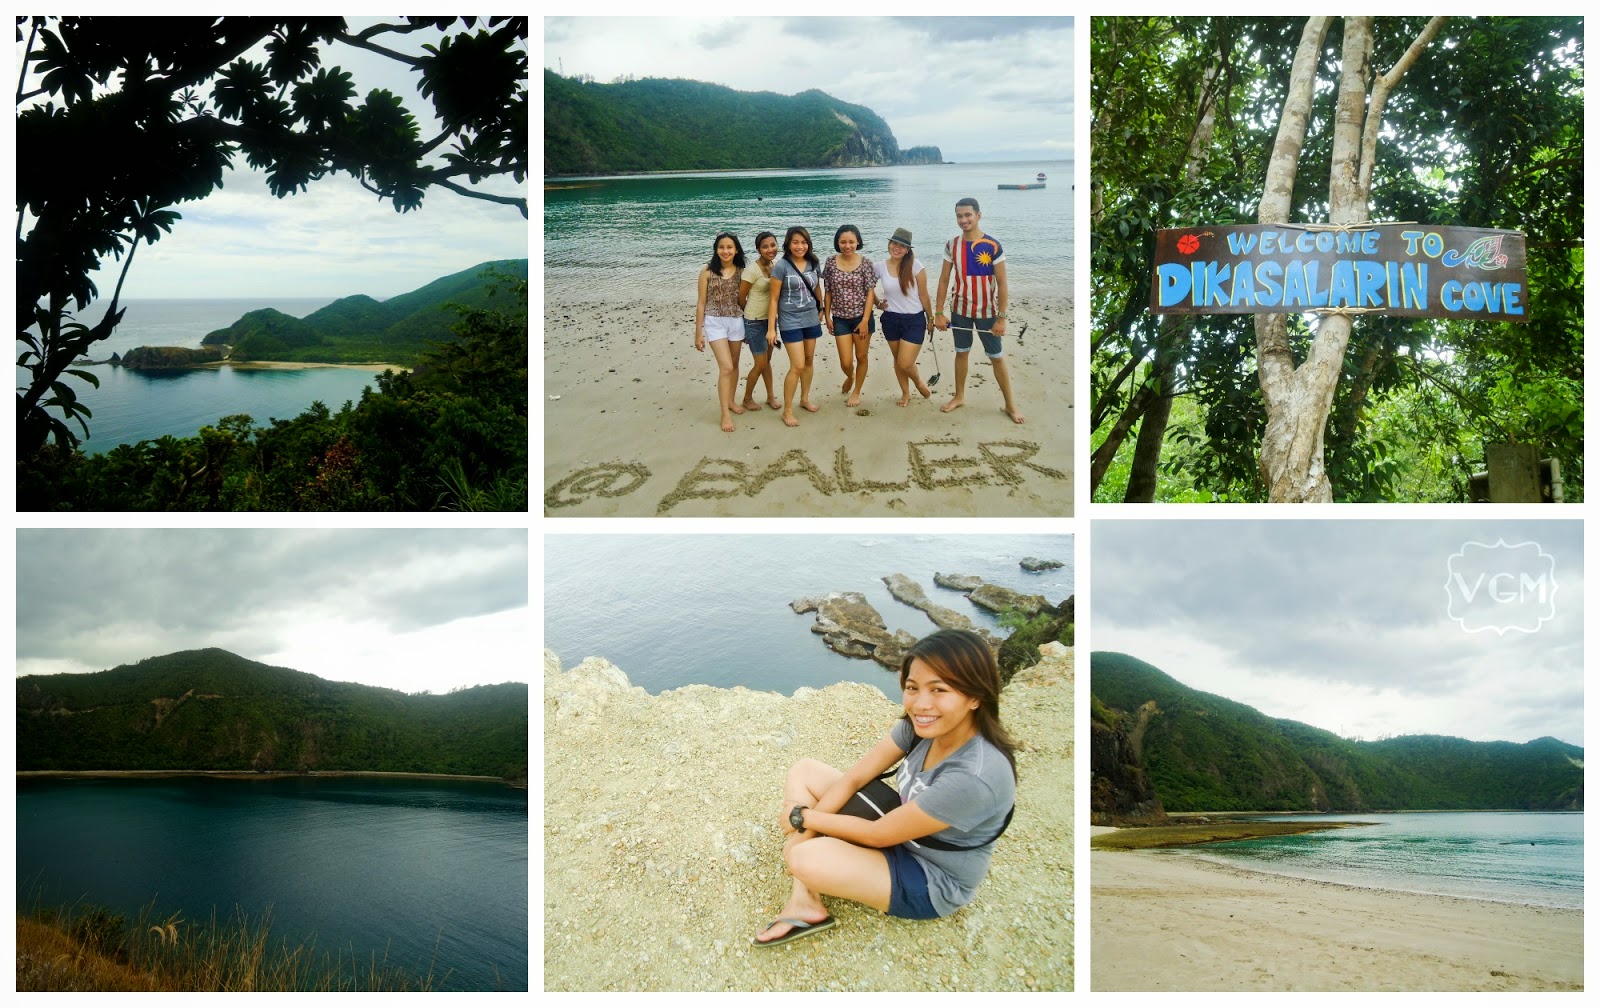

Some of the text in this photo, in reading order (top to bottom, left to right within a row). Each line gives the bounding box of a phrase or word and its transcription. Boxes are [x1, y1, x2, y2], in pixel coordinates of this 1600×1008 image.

[1227, 230, 1445, 258] WELCOME TO
[1156, 258, 1525, 315] DIKASALARIN COVE
